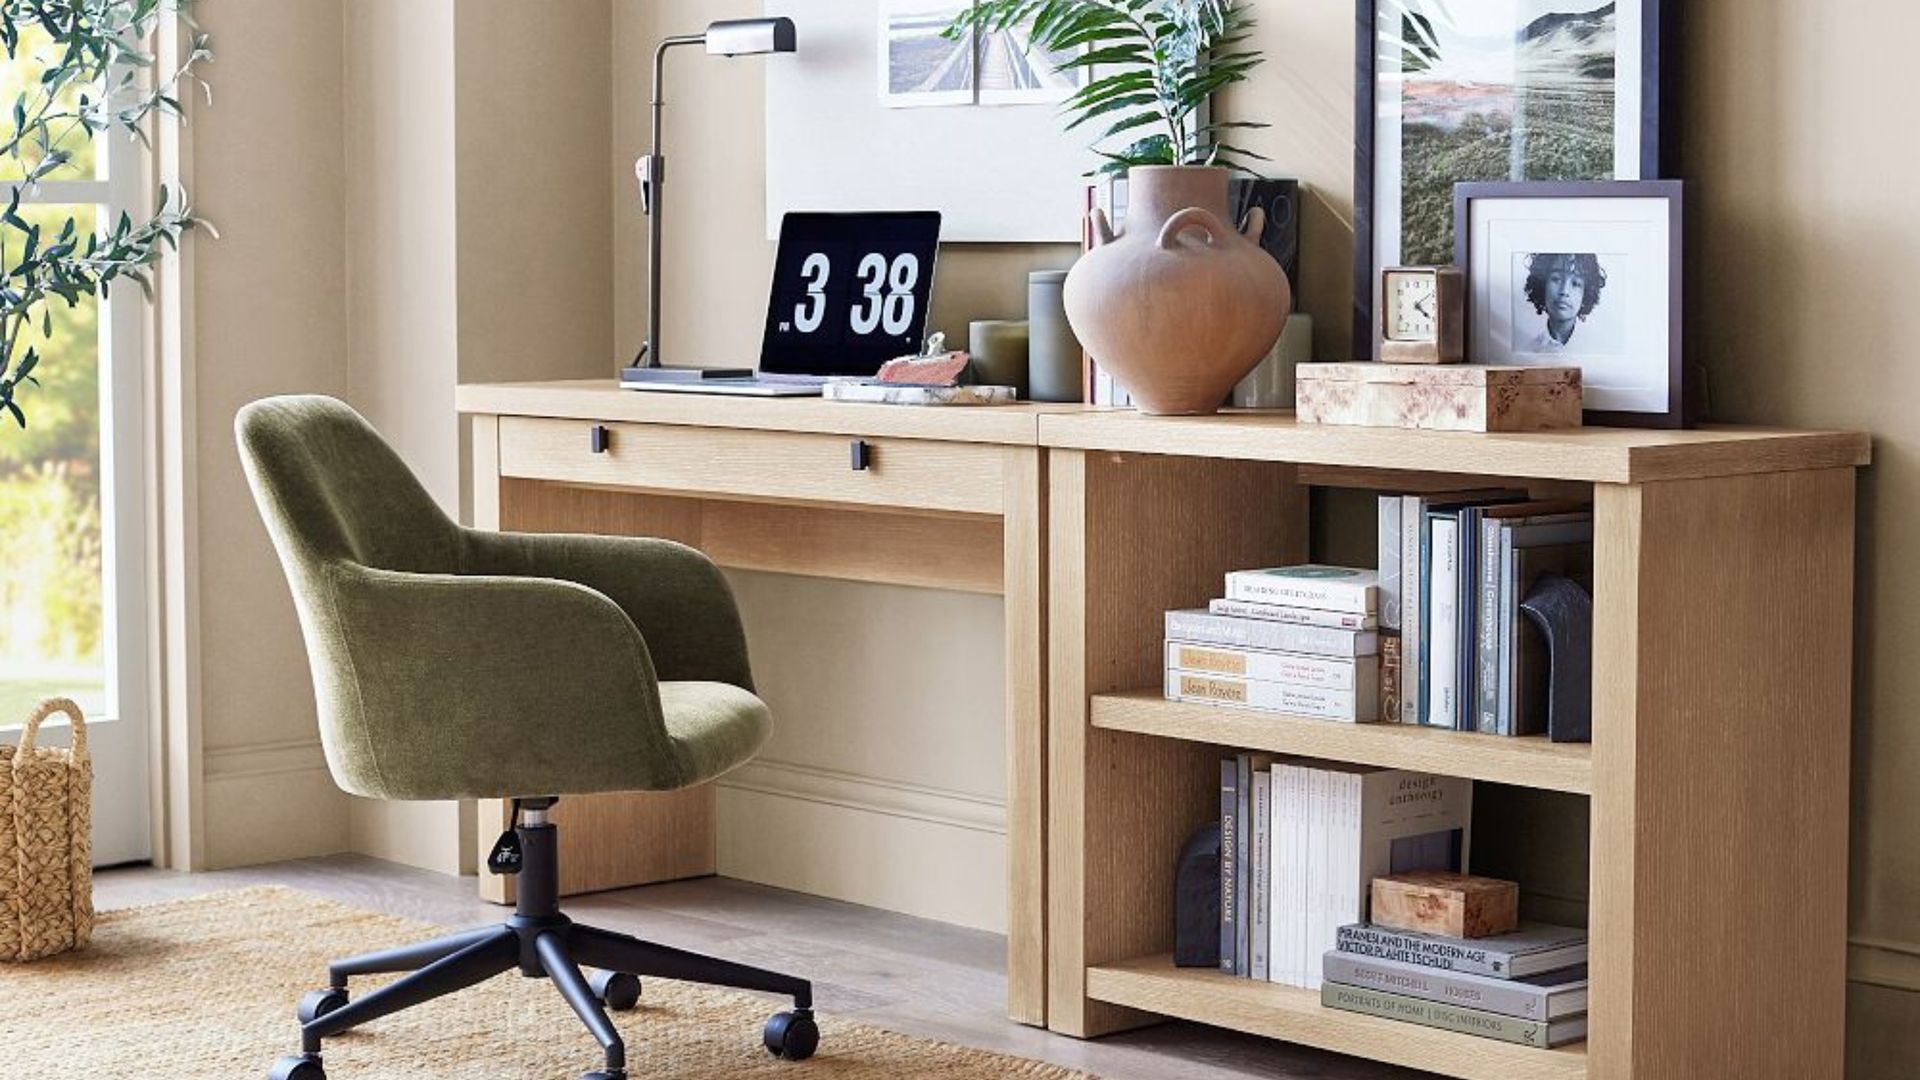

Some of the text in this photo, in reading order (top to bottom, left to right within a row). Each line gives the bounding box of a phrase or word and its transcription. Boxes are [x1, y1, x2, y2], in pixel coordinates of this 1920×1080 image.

[794, 252, 831, 333] 3
[850, 252, 919, 335] 38
[1223, 814, 1233, 923] DESIGN BY NATURE
[1338, 927, 1486, 964] PIRANESI AND THE MODERN AGE
[1338, 938, 1373, 957] VICTOR
[1338, 991, 1381, 1009] PORTRAITS
[1384, 1001, 1395, 1010] OF
[1397, 1003, 1424, 1017] HOME
[1457, 1014, 1503, 1032] INTERIORS
